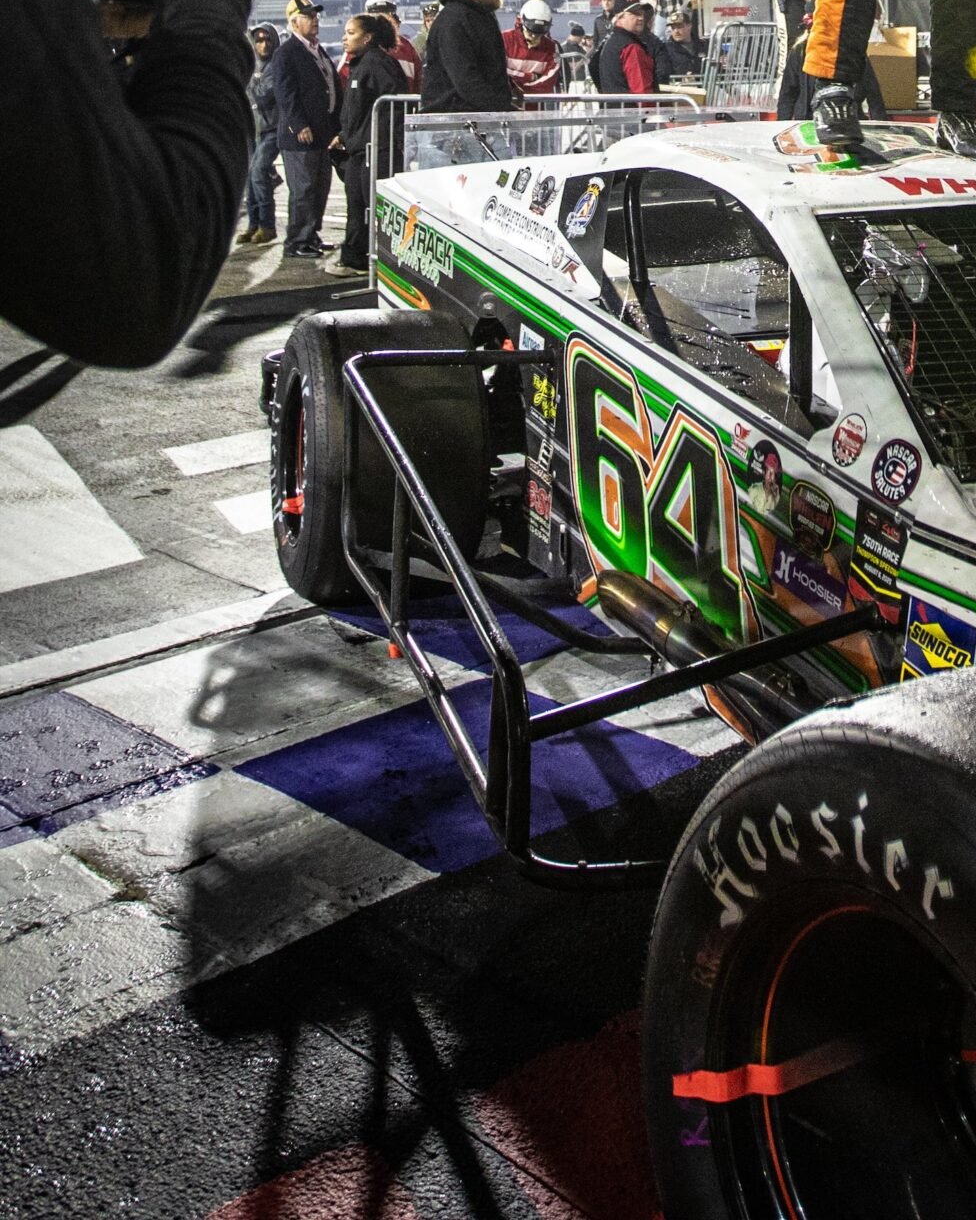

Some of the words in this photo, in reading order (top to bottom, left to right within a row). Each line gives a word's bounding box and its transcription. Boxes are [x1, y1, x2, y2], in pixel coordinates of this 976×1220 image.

[886, 444, 917, 474] NASCAR
[566, 332, 762, 644] 64
[805, 490, 830, 513] NASCAR
[874, 470, 906, 500] SALUTES
[882, 546, 900, 565] RACE
[792, 566, 842, 611] HOOSIER
[910, 623, 971, 669] SUNOCO
[694, 792, 954, 927] Hoosier
